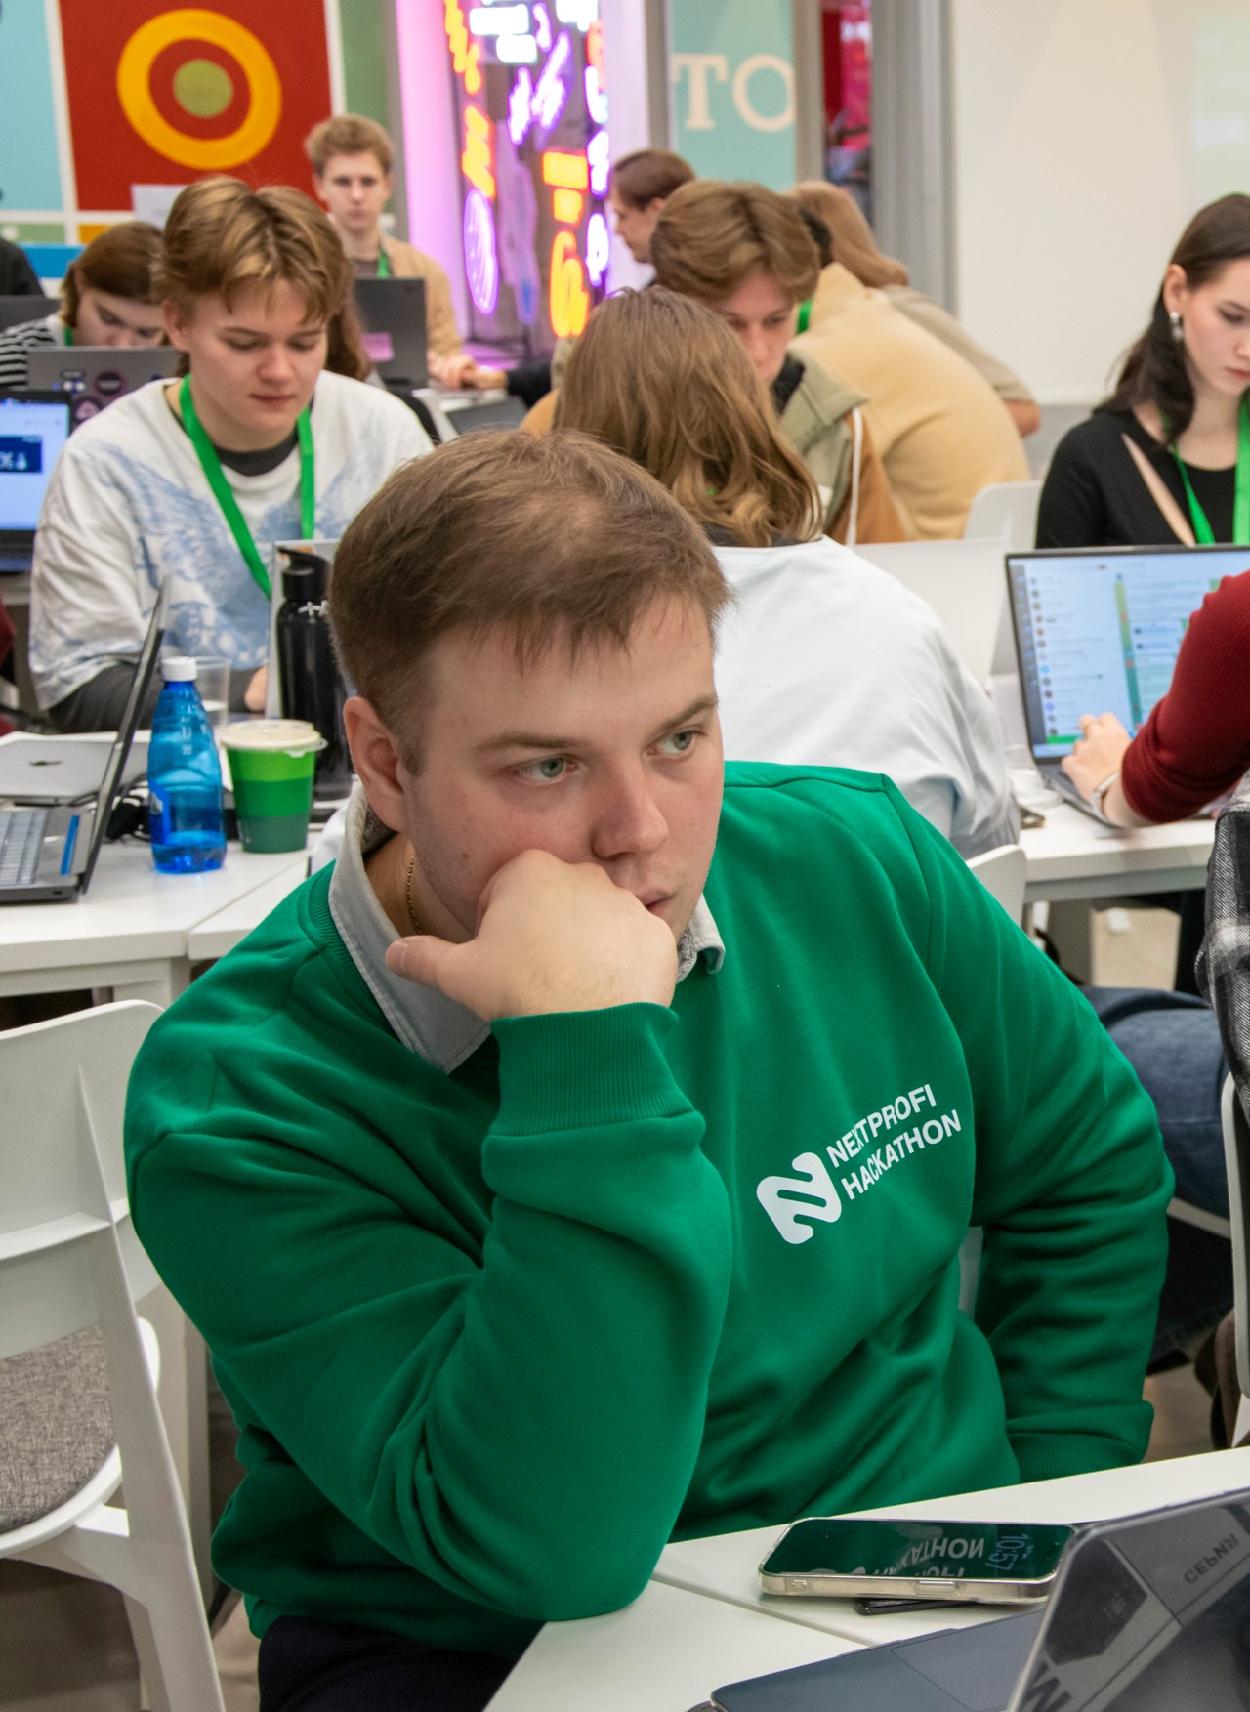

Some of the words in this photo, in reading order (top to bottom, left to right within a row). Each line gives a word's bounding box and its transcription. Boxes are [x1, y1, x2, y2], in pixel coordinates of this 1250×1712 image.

[826, 1083, 937, 1168] NEXTPROFI
[840, 1109, 963, 1200] HACKATHON
[984, 1532, 1029, 1572] 10:57
